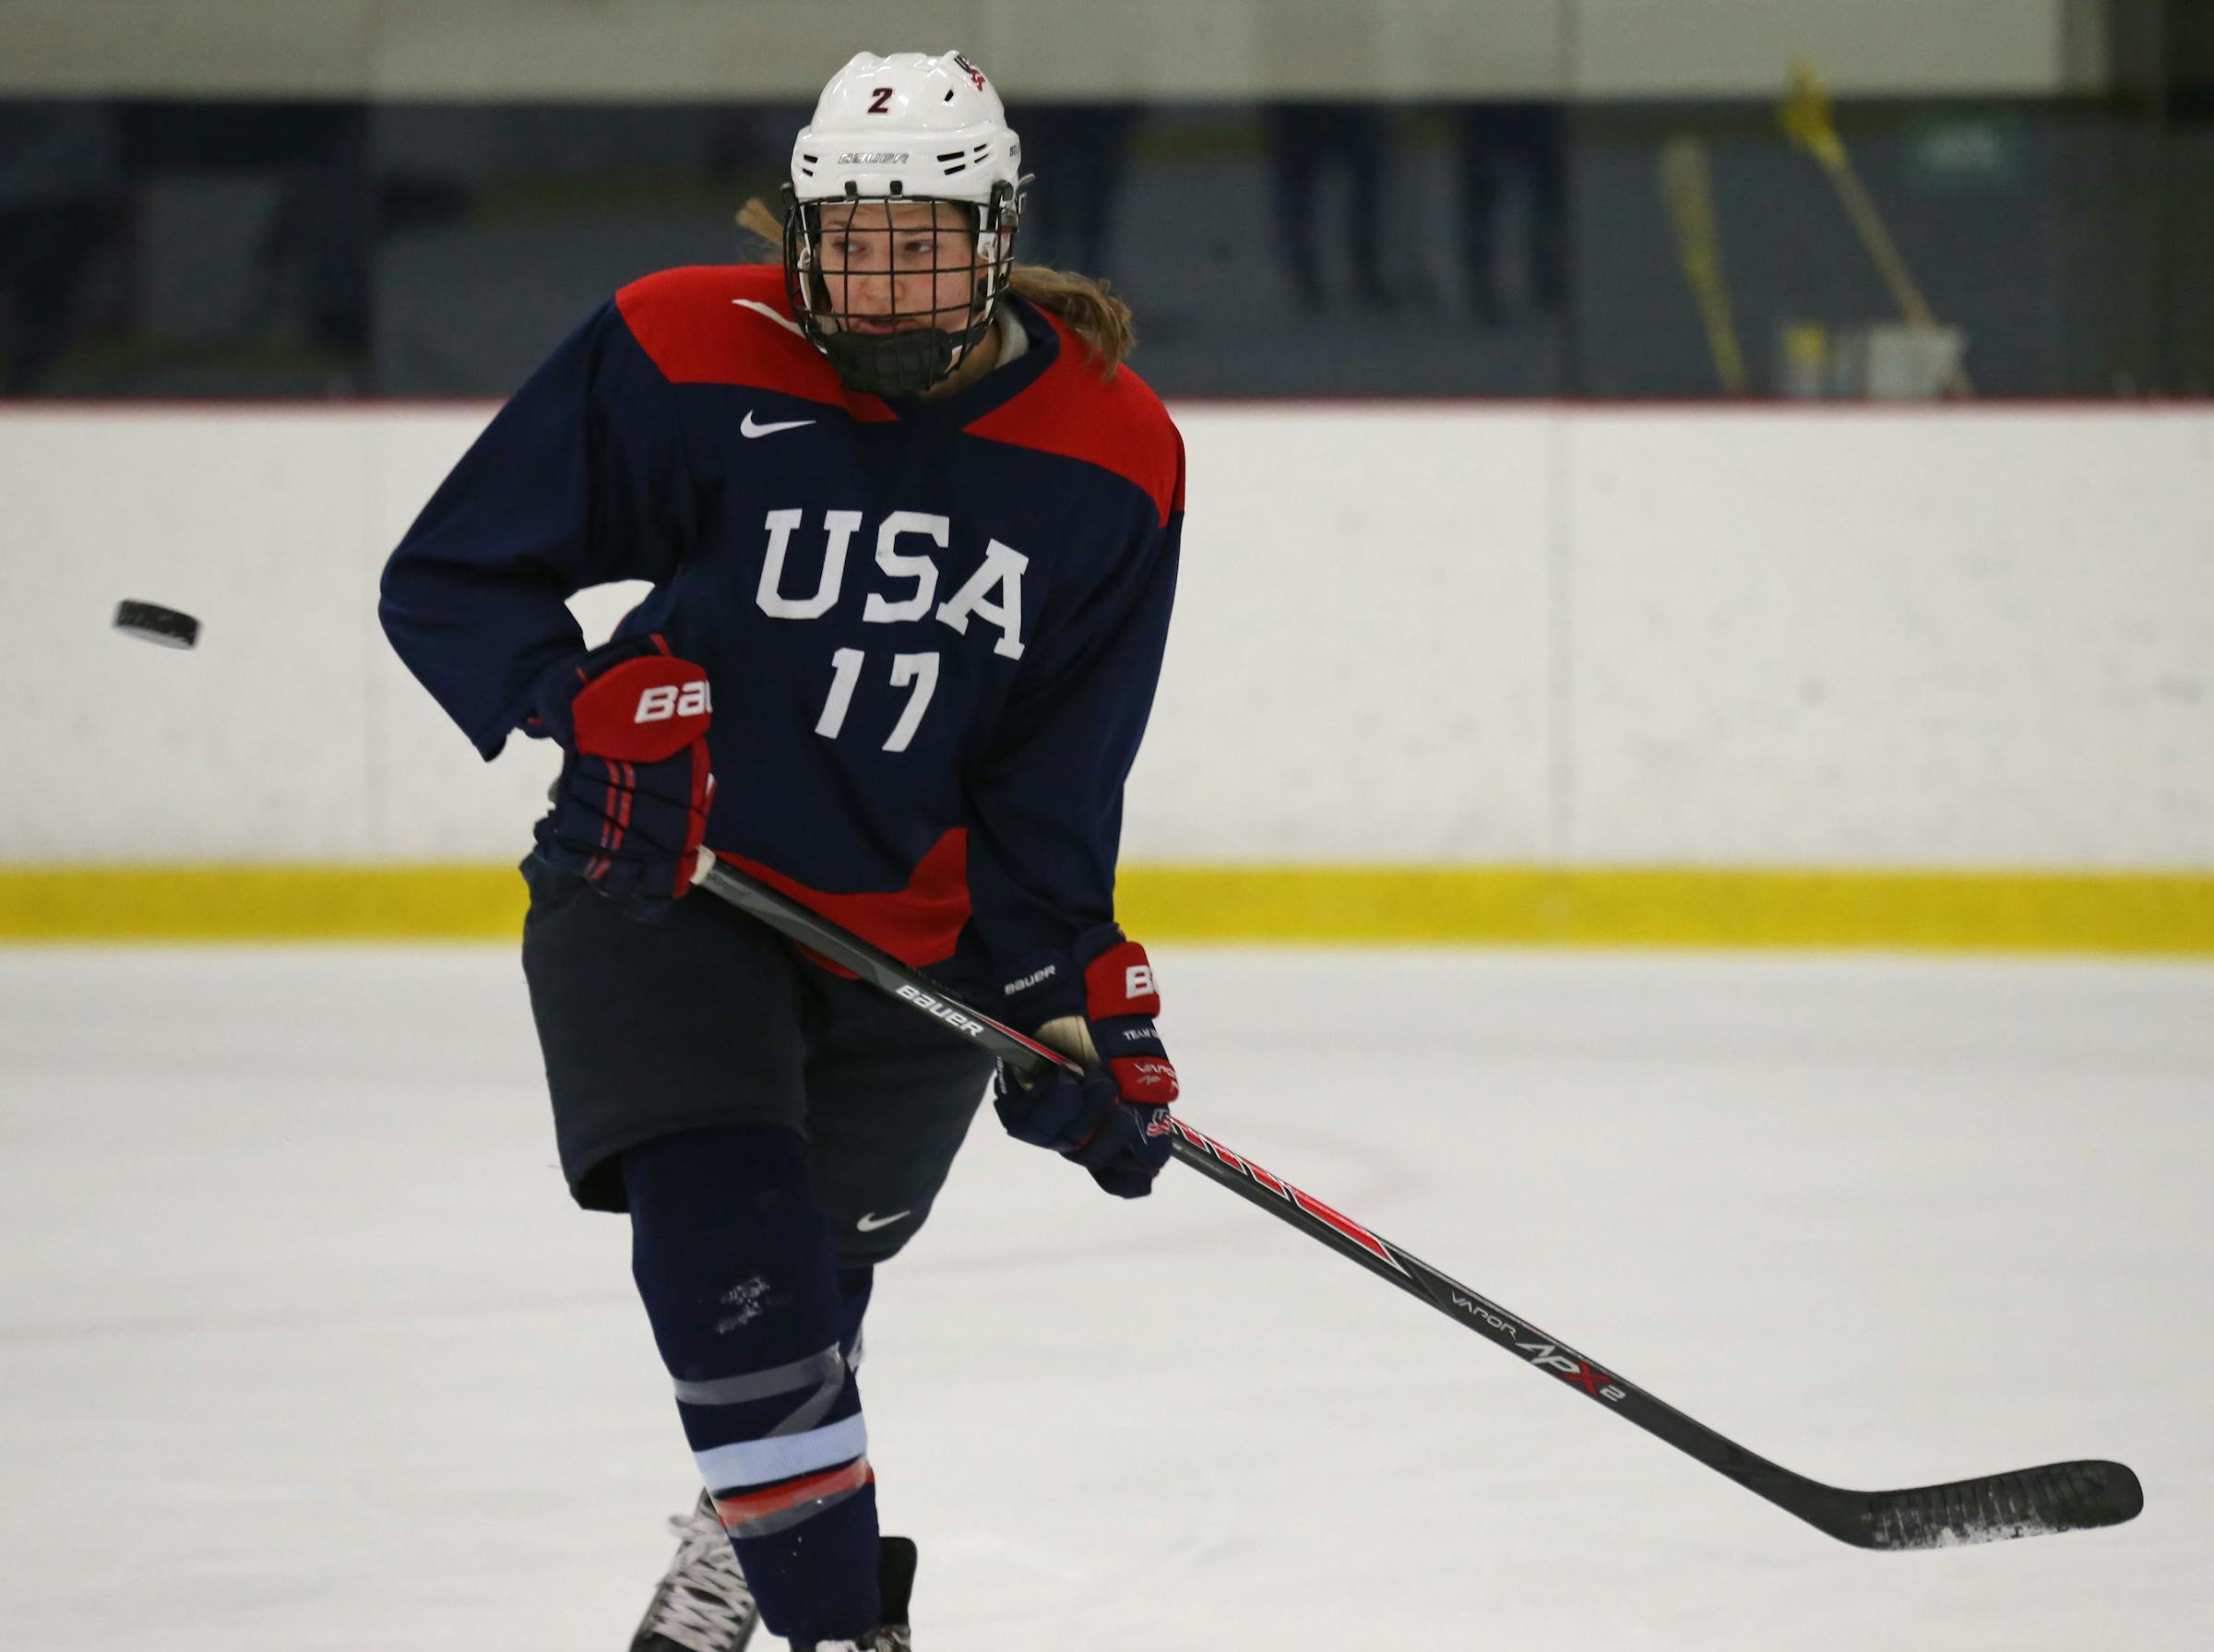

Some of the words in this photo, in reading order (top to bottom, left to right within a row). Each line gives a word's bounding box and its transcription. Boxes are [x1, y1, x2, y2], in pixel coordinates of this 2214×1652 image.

[868, 88, 893, 113] 2
[756, 508, 1030, 660] USA
[814, 647, 940, 753] 17
[1451, 1290, 1517, 1340] VAPOR
